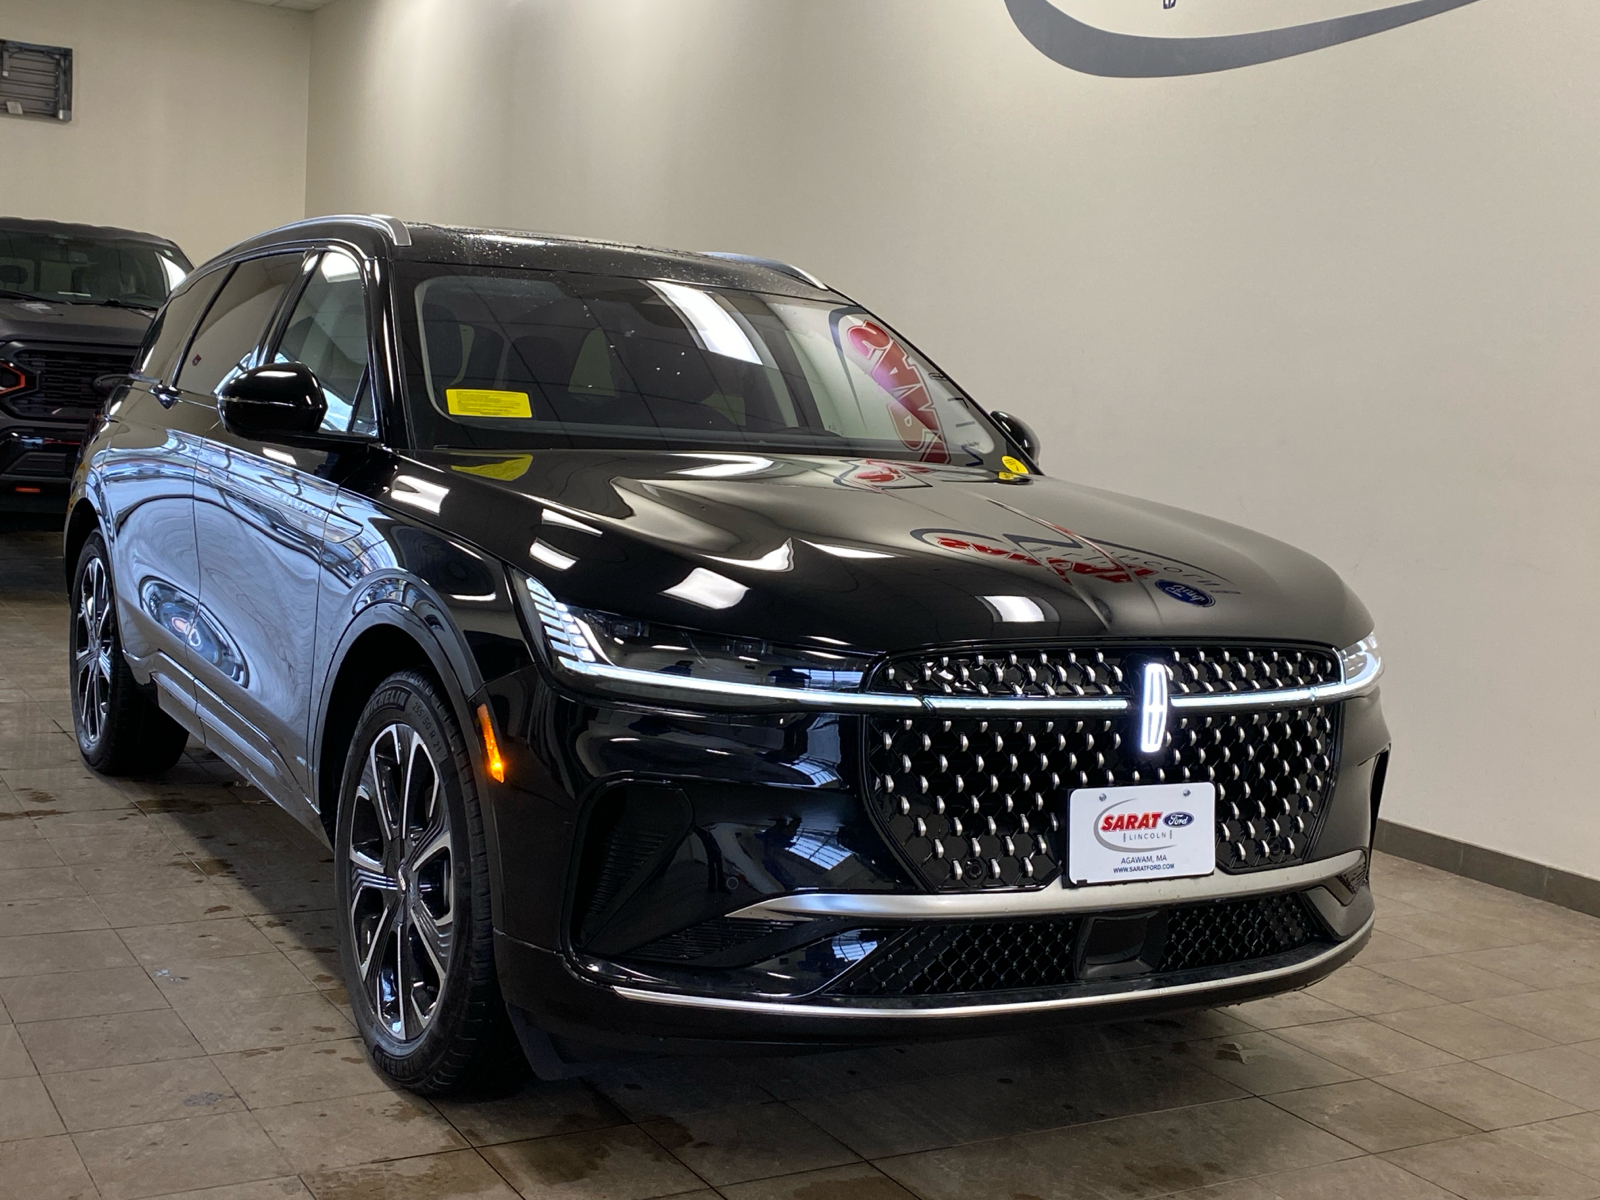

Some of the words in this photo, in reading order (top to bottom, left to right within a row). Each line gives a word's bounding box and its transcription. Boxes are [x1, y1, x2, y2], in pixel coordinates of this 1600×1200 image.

[412, 702, 432, 730] 255/50
[433, 741, 442, 753] 21
[1101, 812, 1162, 832] SARAT
[1167, 814, 1189, 826] Ford
[1129, 832, 1166, 840] LINCOLN
[1121, 855, 1154, 864] AGAWAM,
[1156, 854, 1167, 862] MA
[1113, 863, 1175, 873] WWW.SARATFORD.COM
